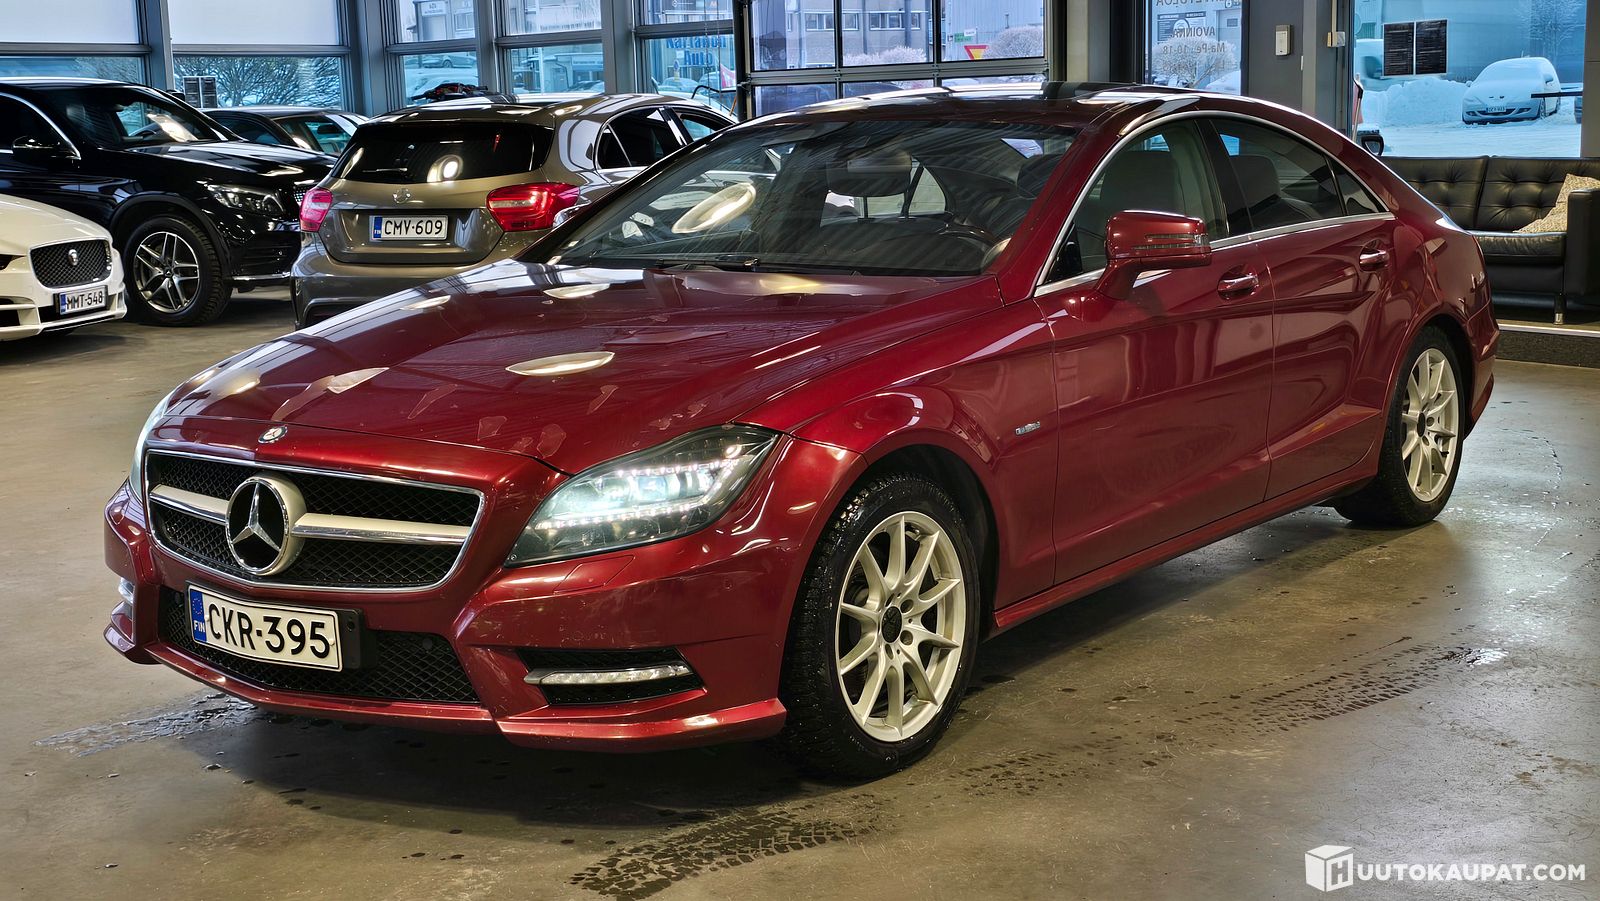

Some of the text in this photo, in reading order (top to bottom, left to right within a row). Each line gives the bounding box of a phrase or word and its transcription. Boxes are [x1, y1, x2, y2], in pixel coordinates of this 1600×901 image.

[684, 50, 713, 65] Auto
[384, 219, 443, 235] CMV-609
[66, 290, 103, 310] MMT-548
[193, 619, 206, 633] FIN
[208, 603, 330, 659] CKR-395
